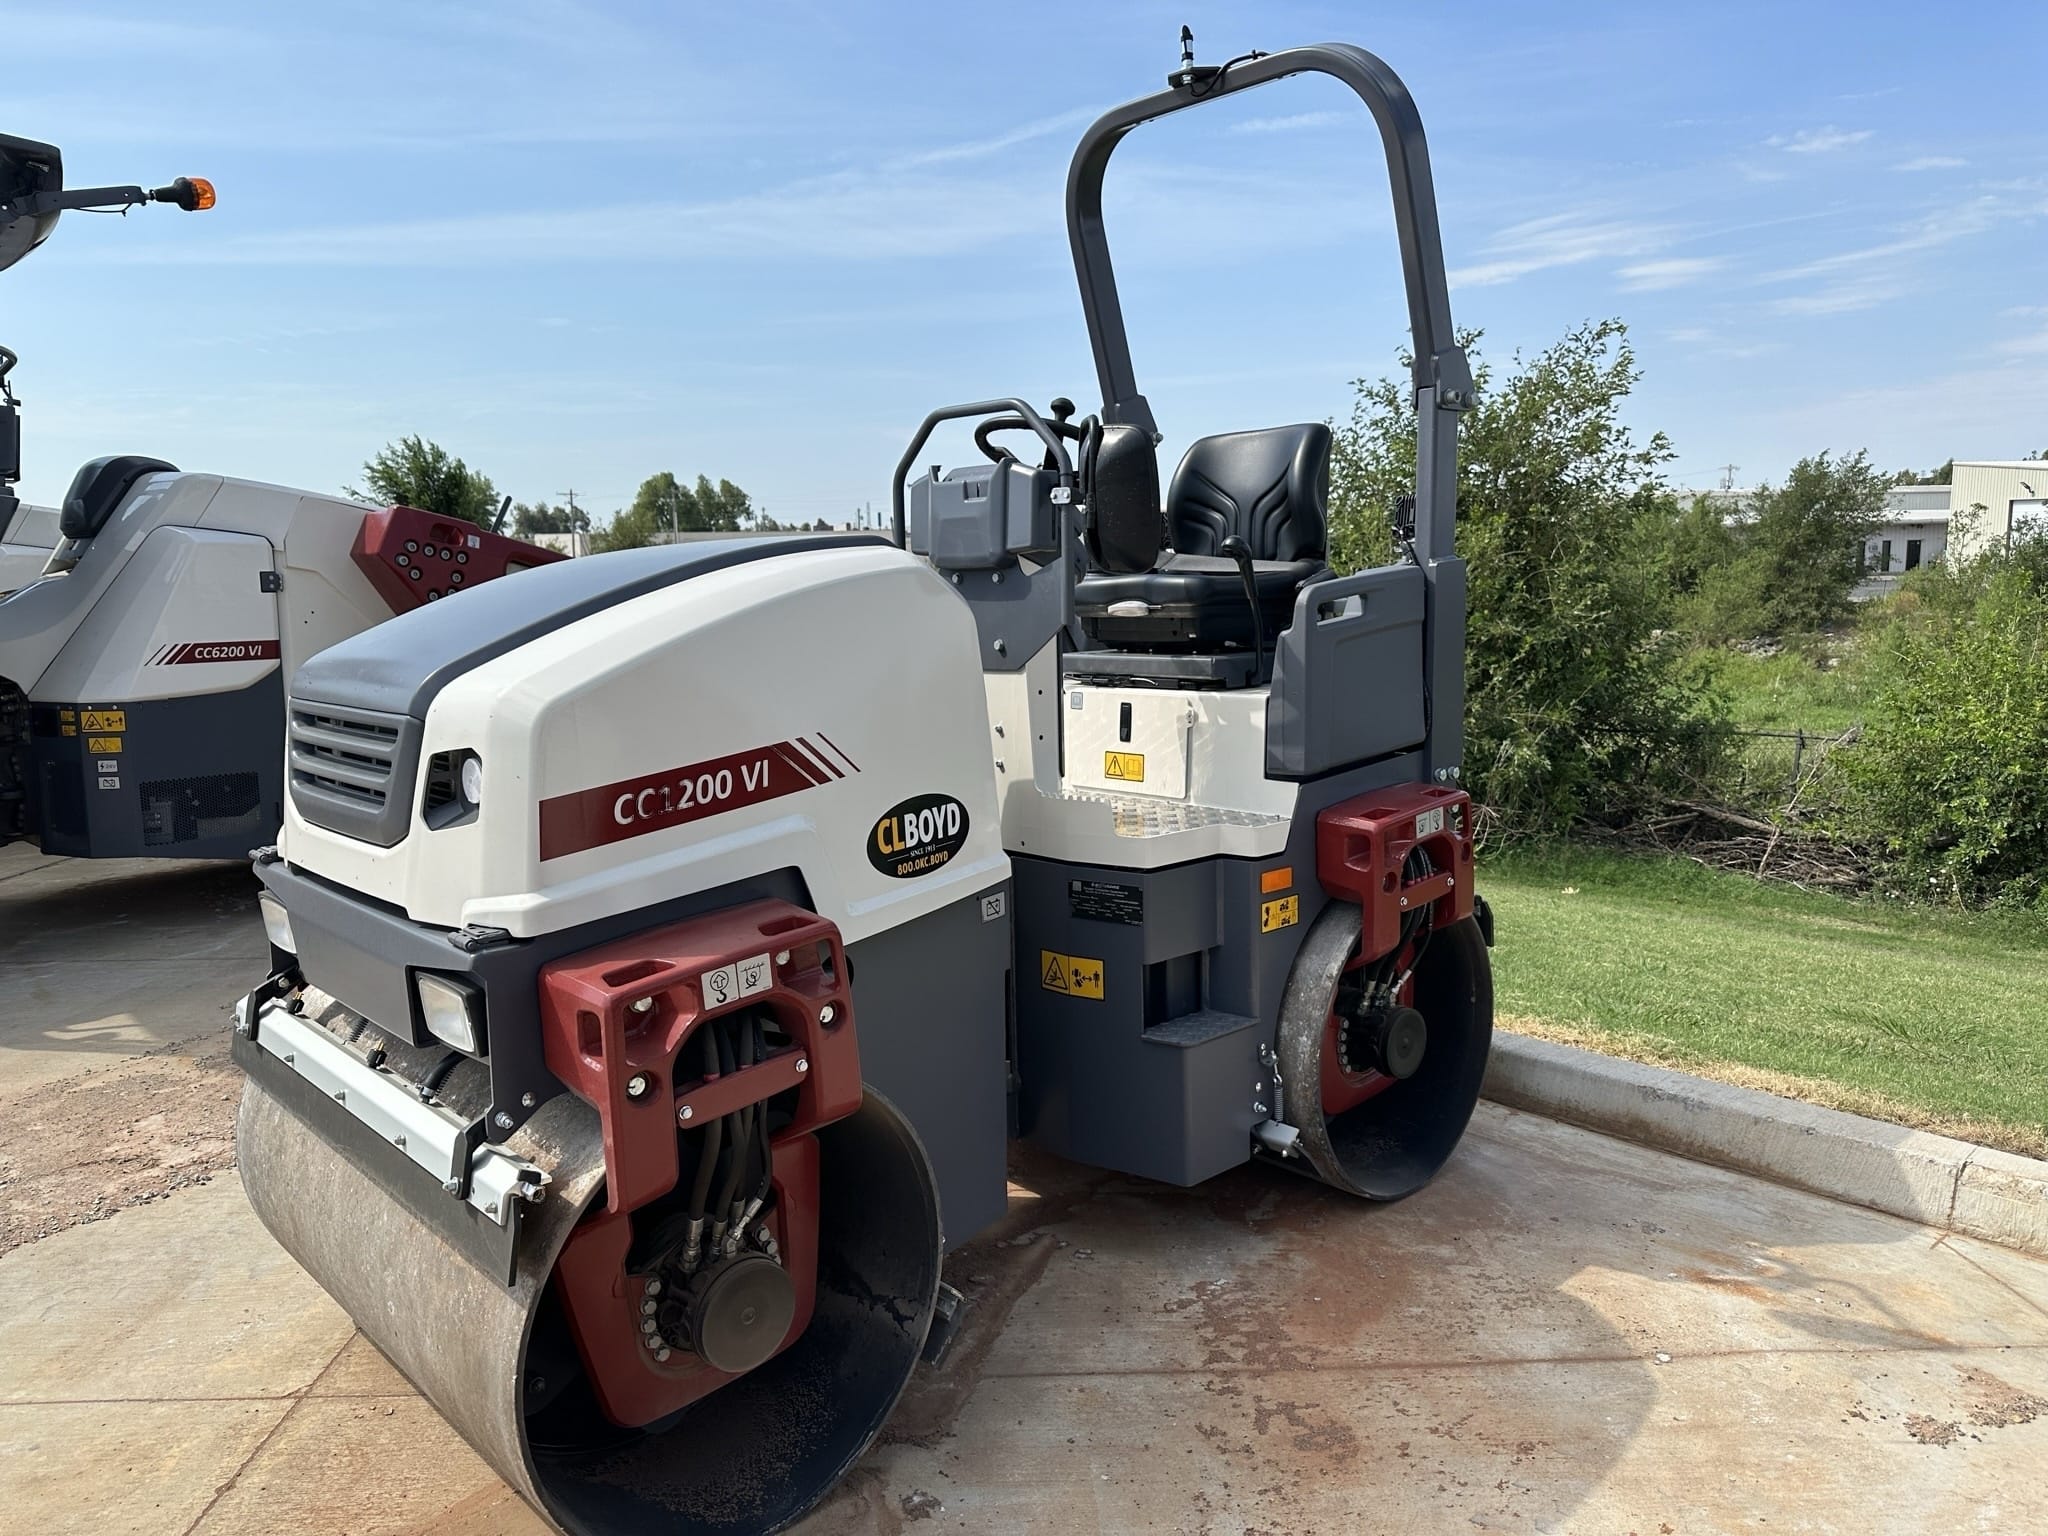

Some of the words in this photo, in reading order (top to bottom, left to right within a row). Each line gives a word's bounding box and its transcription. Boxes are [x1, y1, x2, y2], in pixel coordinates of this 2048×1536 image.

[194, 645, 245, 659] CC6200
[248, 644, 262, 657] VI
[613, 769, 734, 825] CC1200
[740, 759, 769, 793] VI
[910, 847, 924, 858] SINCE
[925, 844, 936, 854] 1913
[897, 850, 949, 876] 800.OKC.BOYD
